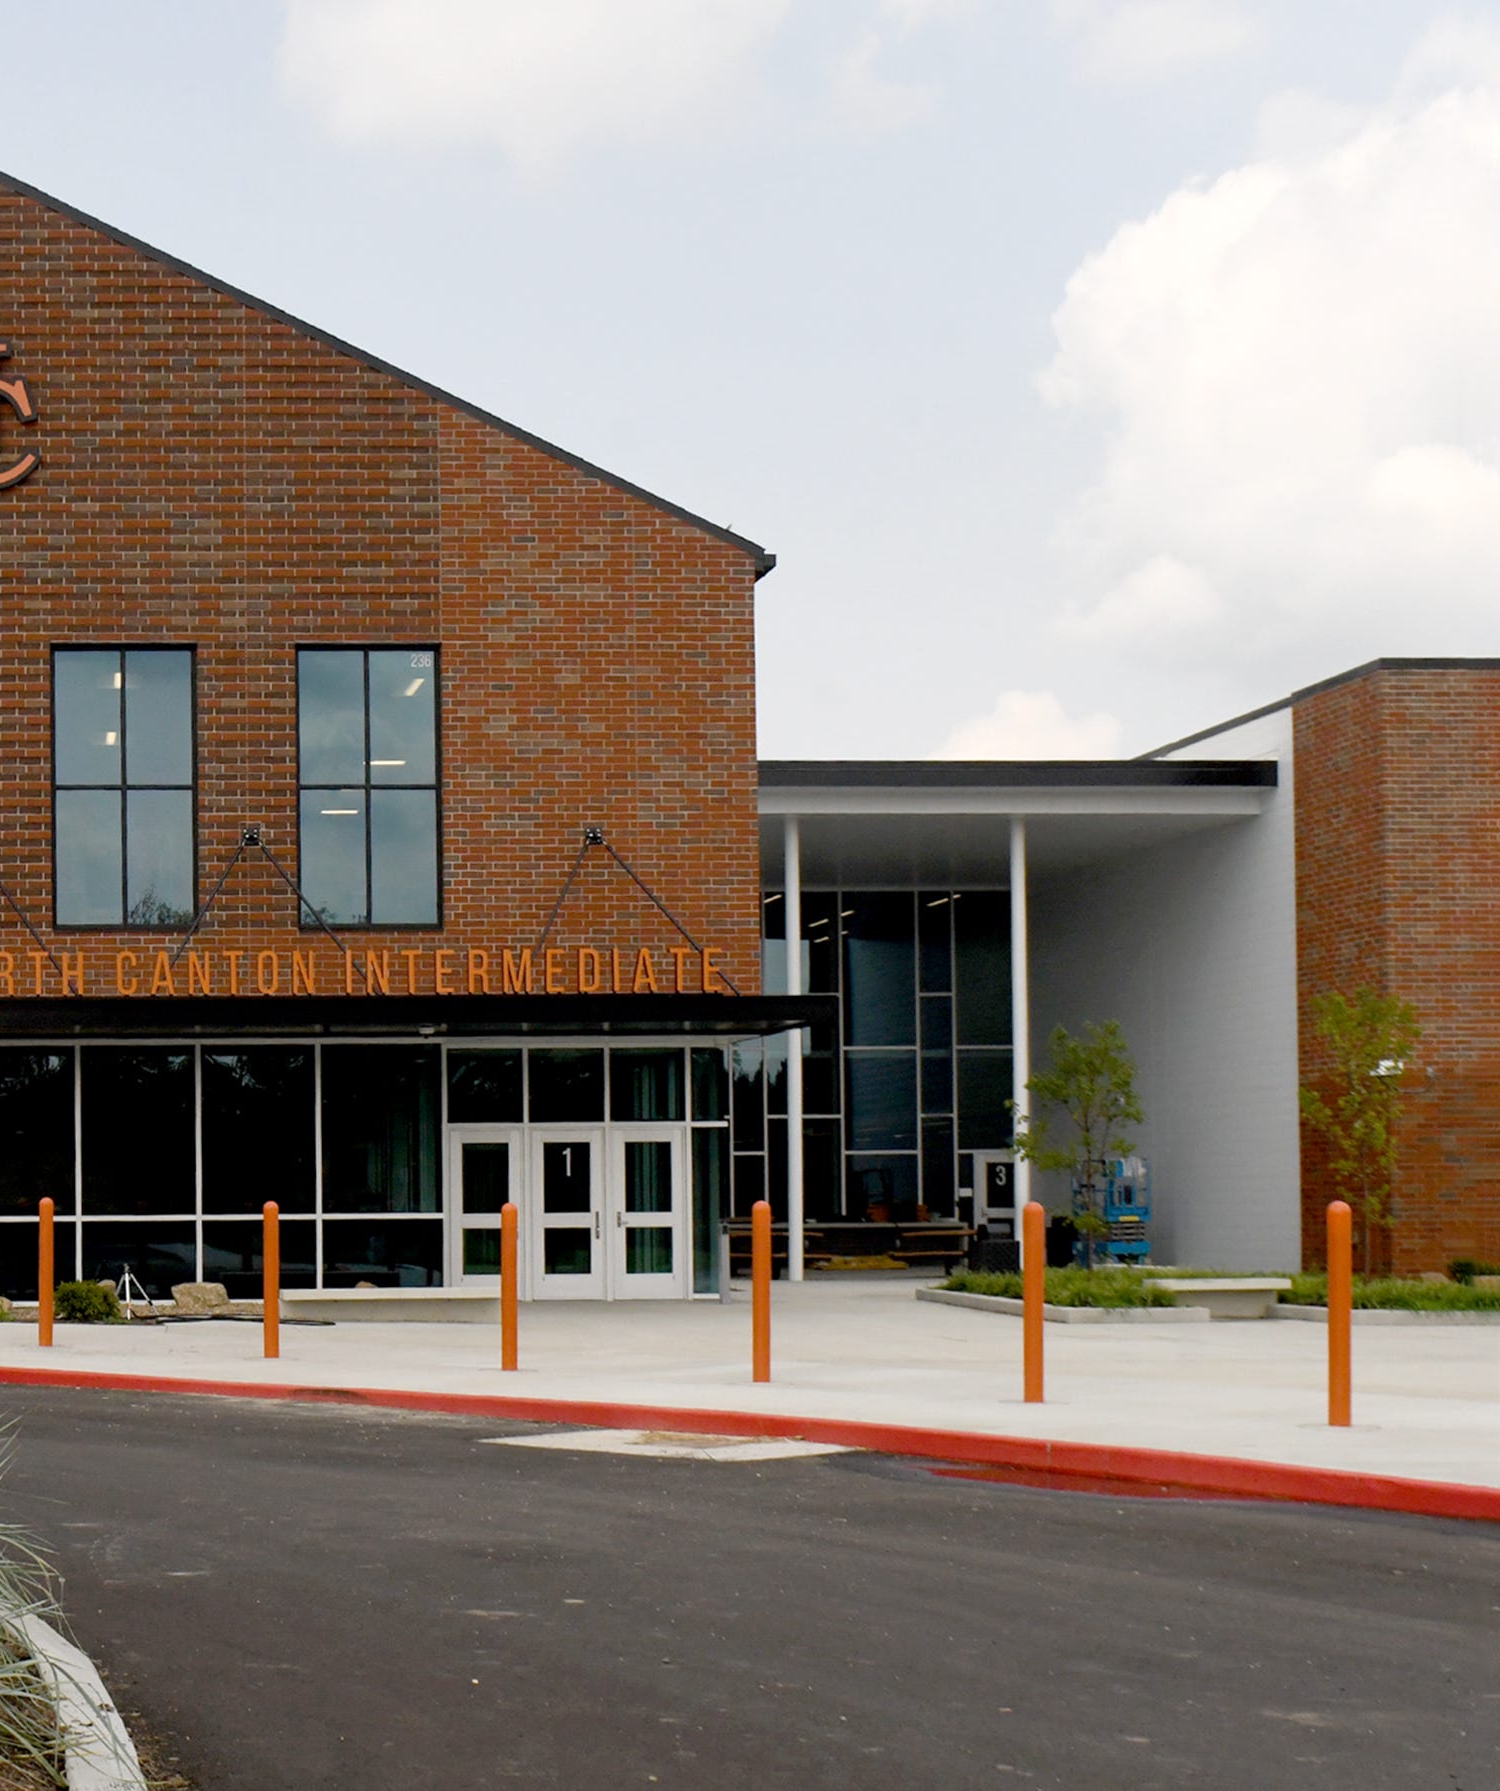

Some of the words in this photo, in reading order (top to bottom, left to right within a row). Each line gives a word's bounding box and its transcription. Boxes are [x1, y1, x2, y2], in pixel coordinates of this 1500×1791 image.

[411, 653, 431, 668] 236
[116, 950, 316, 996] CANTON
[345, 947, 723, 995] INTERMEDIATE
[562, 1147, 571, 1177] 1
[995, 1165, 1006, 1186] 3
